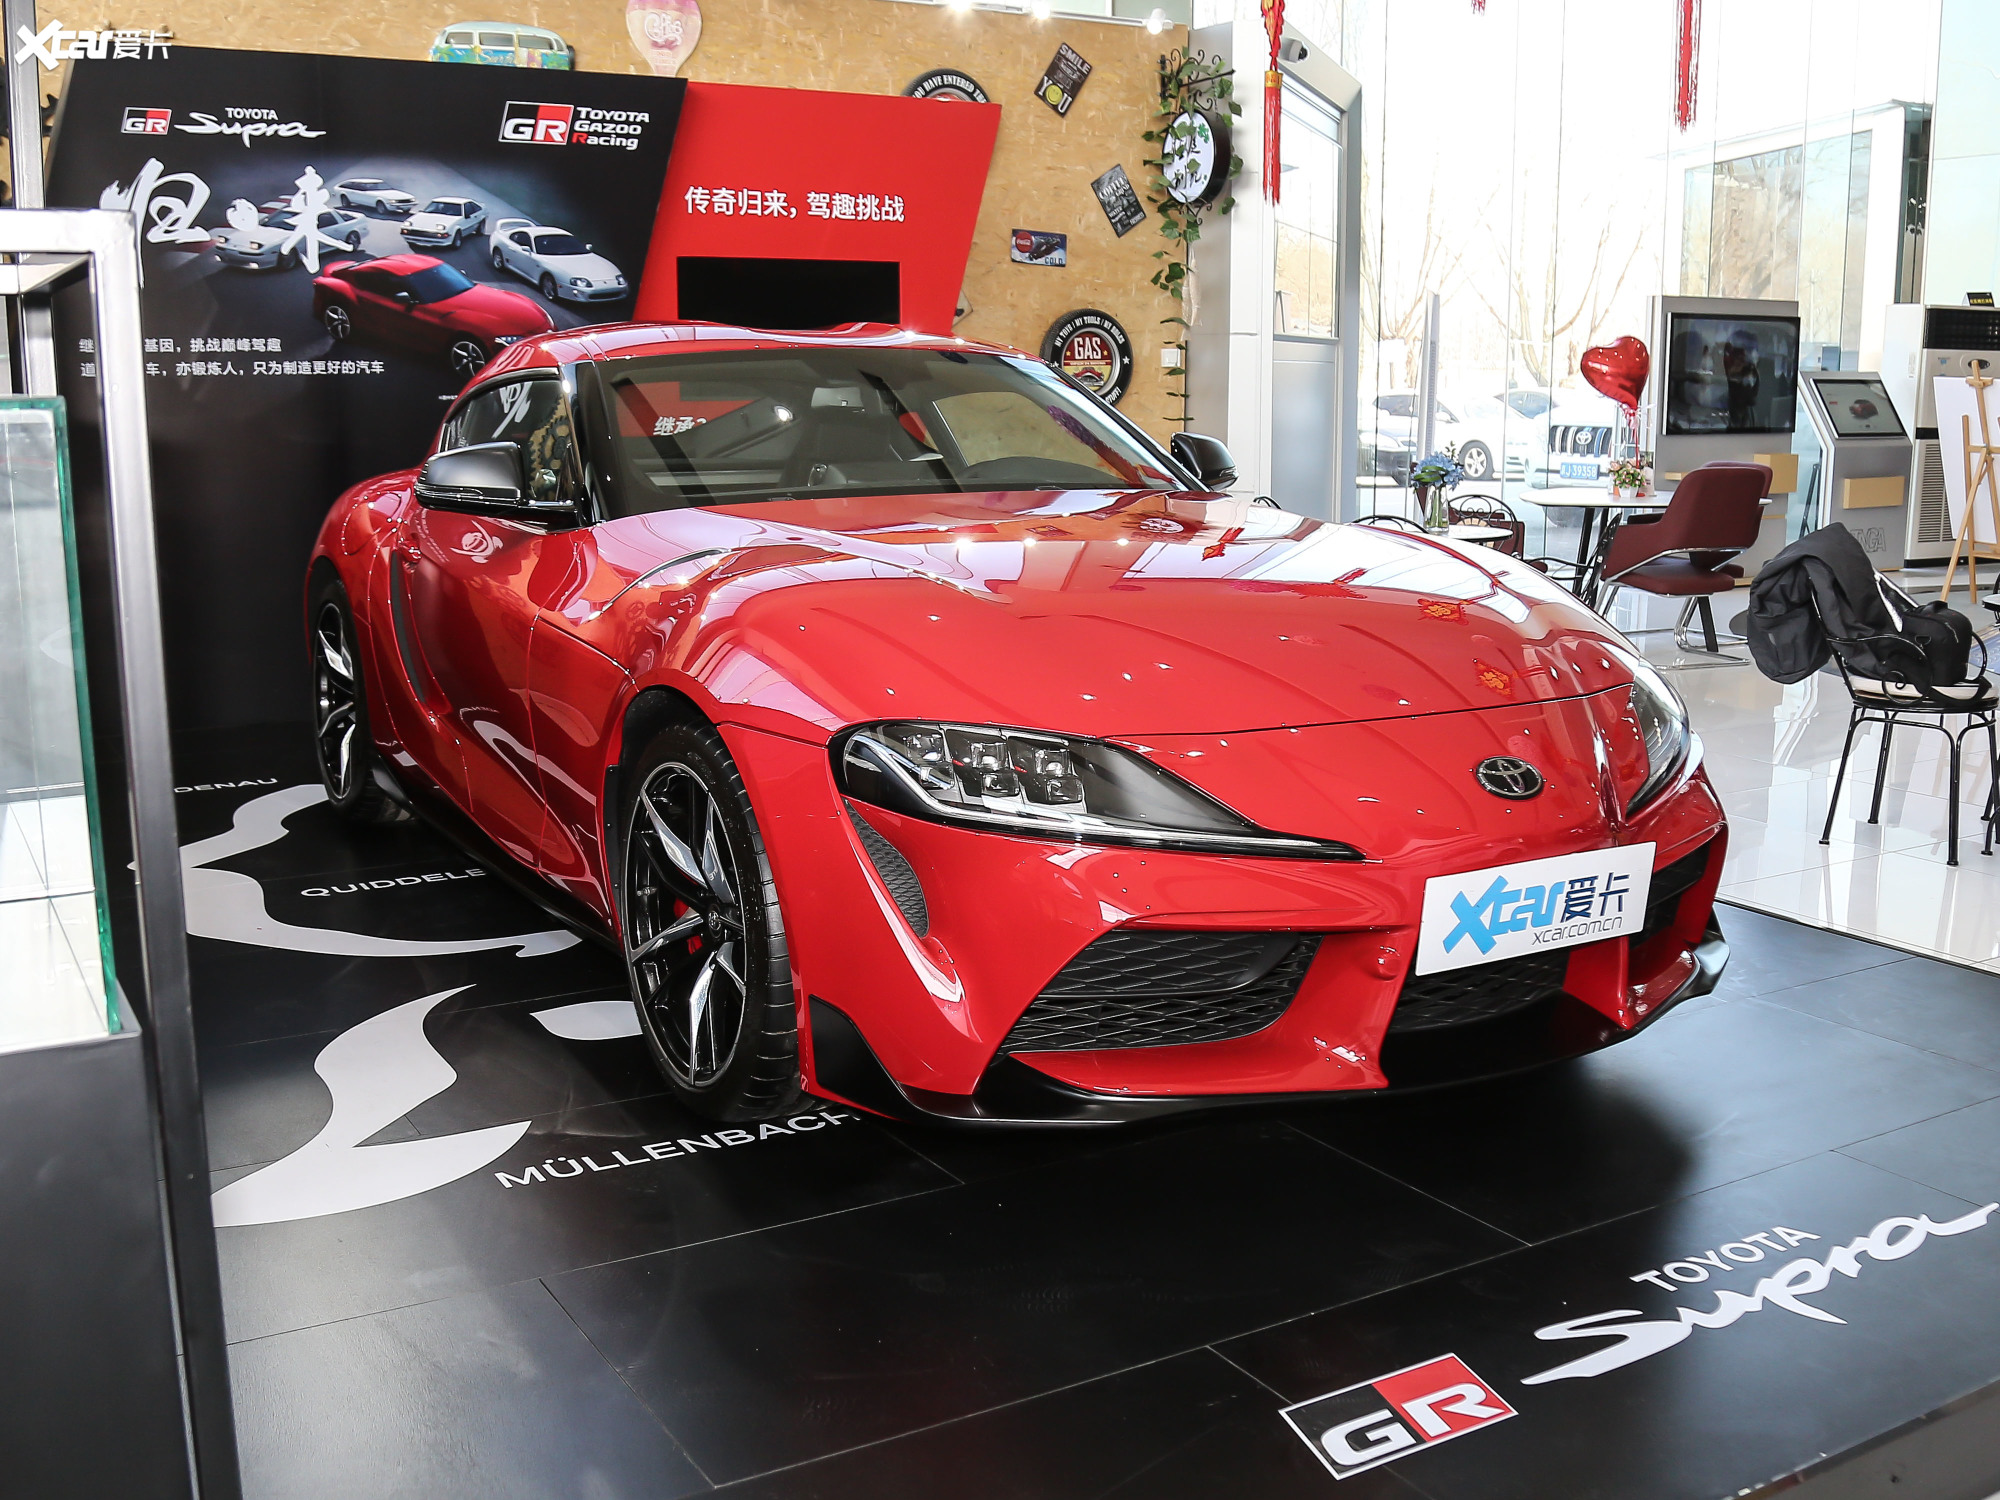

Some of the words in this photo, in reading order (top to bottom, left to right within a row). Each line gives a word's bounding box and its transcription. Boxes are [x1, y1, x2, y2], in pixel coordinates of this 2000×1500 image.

[1060, 44, 1091, 75] SMILE
[922, 75, 943, 92] HAVE
[942, 74, 975, 93] ENTERED
[124, 115, 169, 134] GR
[224, 106, 279, 121] TOYOTA
[576, 106, 650, 123] TOYOTA
[174, 111, 327, 148] Supra
[503, 115, 569, 144] GR
[573, 119, 643, 135] GAZOO
[571, 131, 640, 151] Racing
[1044, 257, 1063, 265] COLD
[1054, 337, 1064, 347] MY
[1059, 323, 1073, 338] TOYS
[1074, 317, 1083, 327] MY
[1083, 315, 1101, 324] TOOLS
[1103, 320, 1112, 330] MY
[79, 338, 282, 353] 继基因，挑战巅峰驾趣
[1074, 336, 1102, 360] GAS
[80, 360, 385, 377] 道车，亦锻炼人，只为制造更好的汽车
[173, 777, 279, 793] DENAU
[1532, 916, 1623, 946] xcar.com.cn
[494, 1110, 861, 1188] MÜLLENBACH
[1629, 1225, 1821, 1293] TOYOTA
[1520, 1201, 1999, 1387] Supra
[1318, 1380, 1507, 1469] GR
